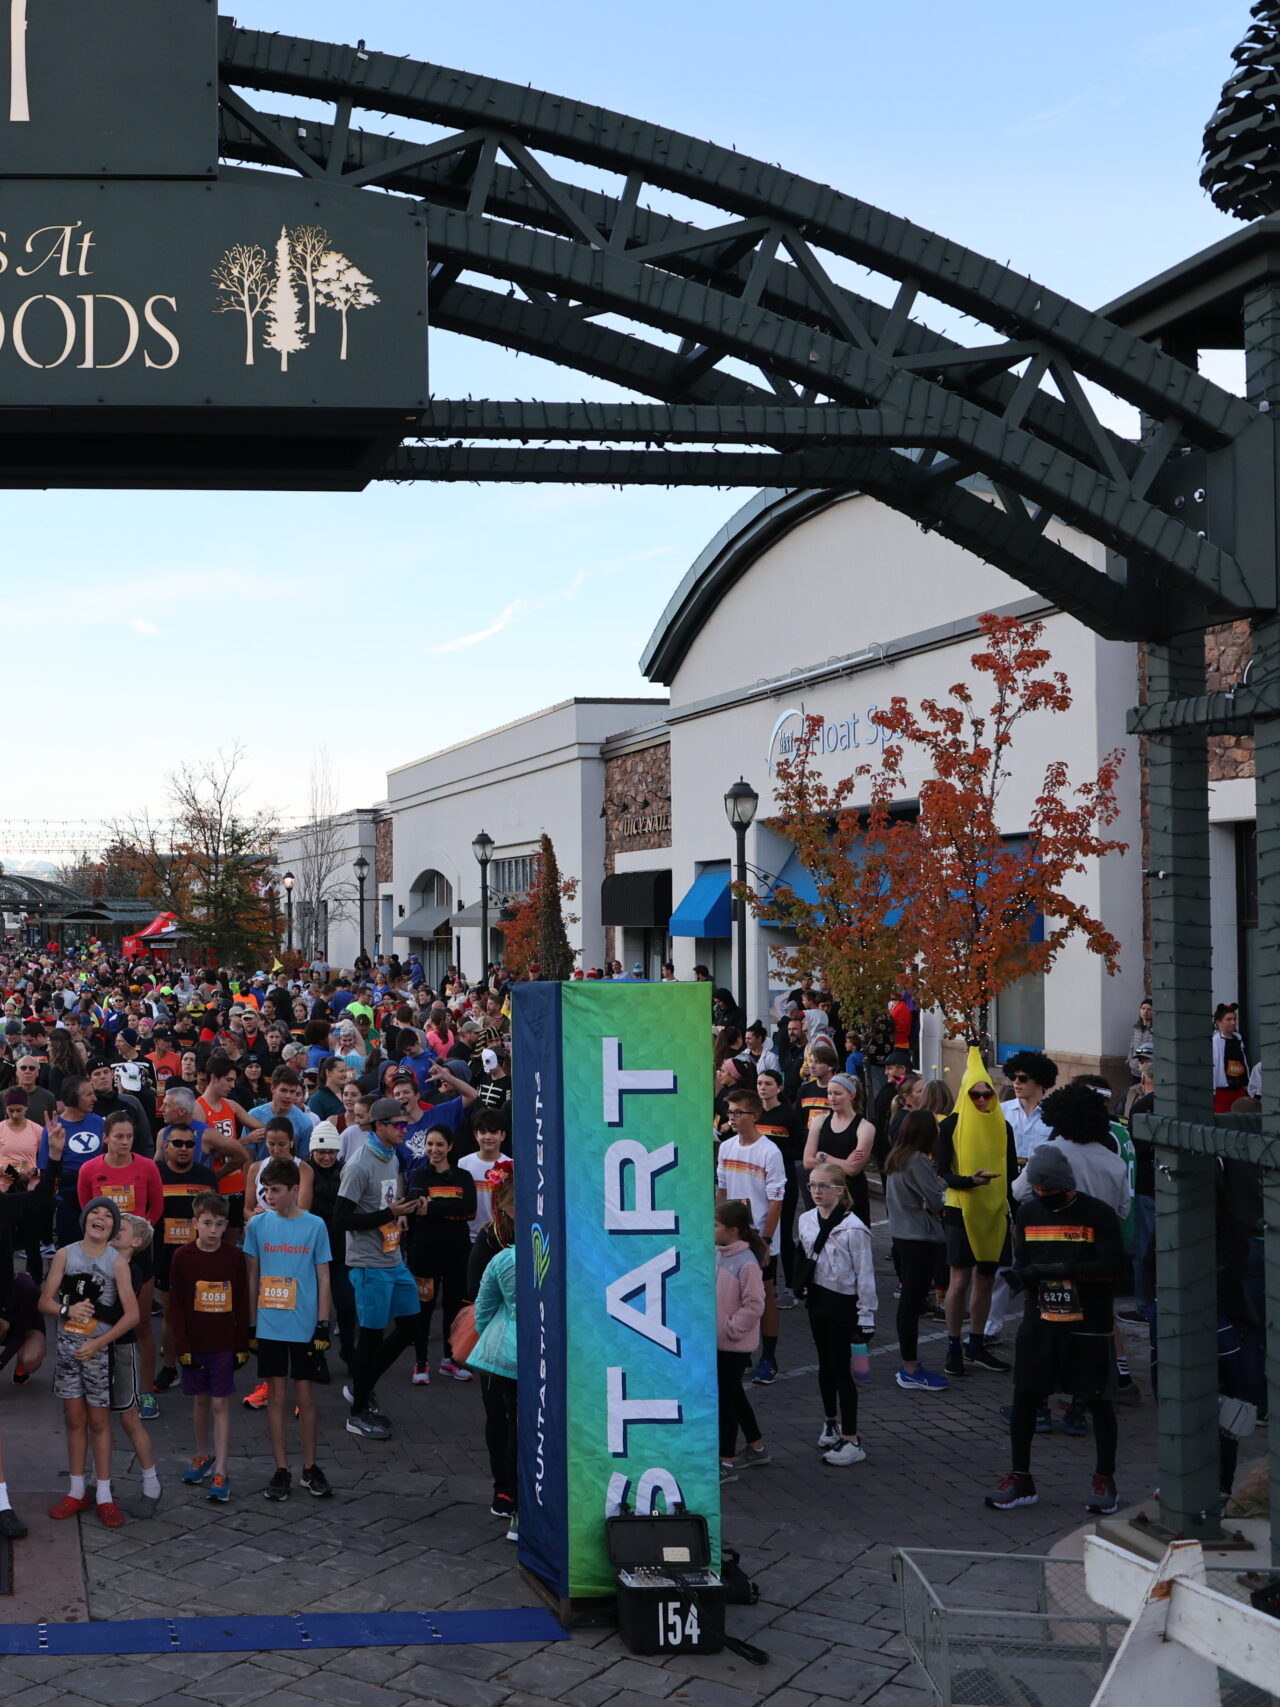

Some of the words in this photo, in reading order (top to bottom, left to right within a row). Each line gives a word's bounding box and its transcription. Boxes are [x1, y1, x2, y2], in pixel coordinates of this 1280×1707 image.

[16, 220, 96, 276] At
[72, 1133, 94, 1151] Y
[534, 1071, 545, 1216] EVENTS
[201, 1291, 227, 1302] 2058
[264, 1287, 289, 1298] 2059
[1043, 1292, 1071, 1304] 6279
[534, 1300, 548, 1507] RUNTASTIC
[658, 1600, 701, 1647] 154
